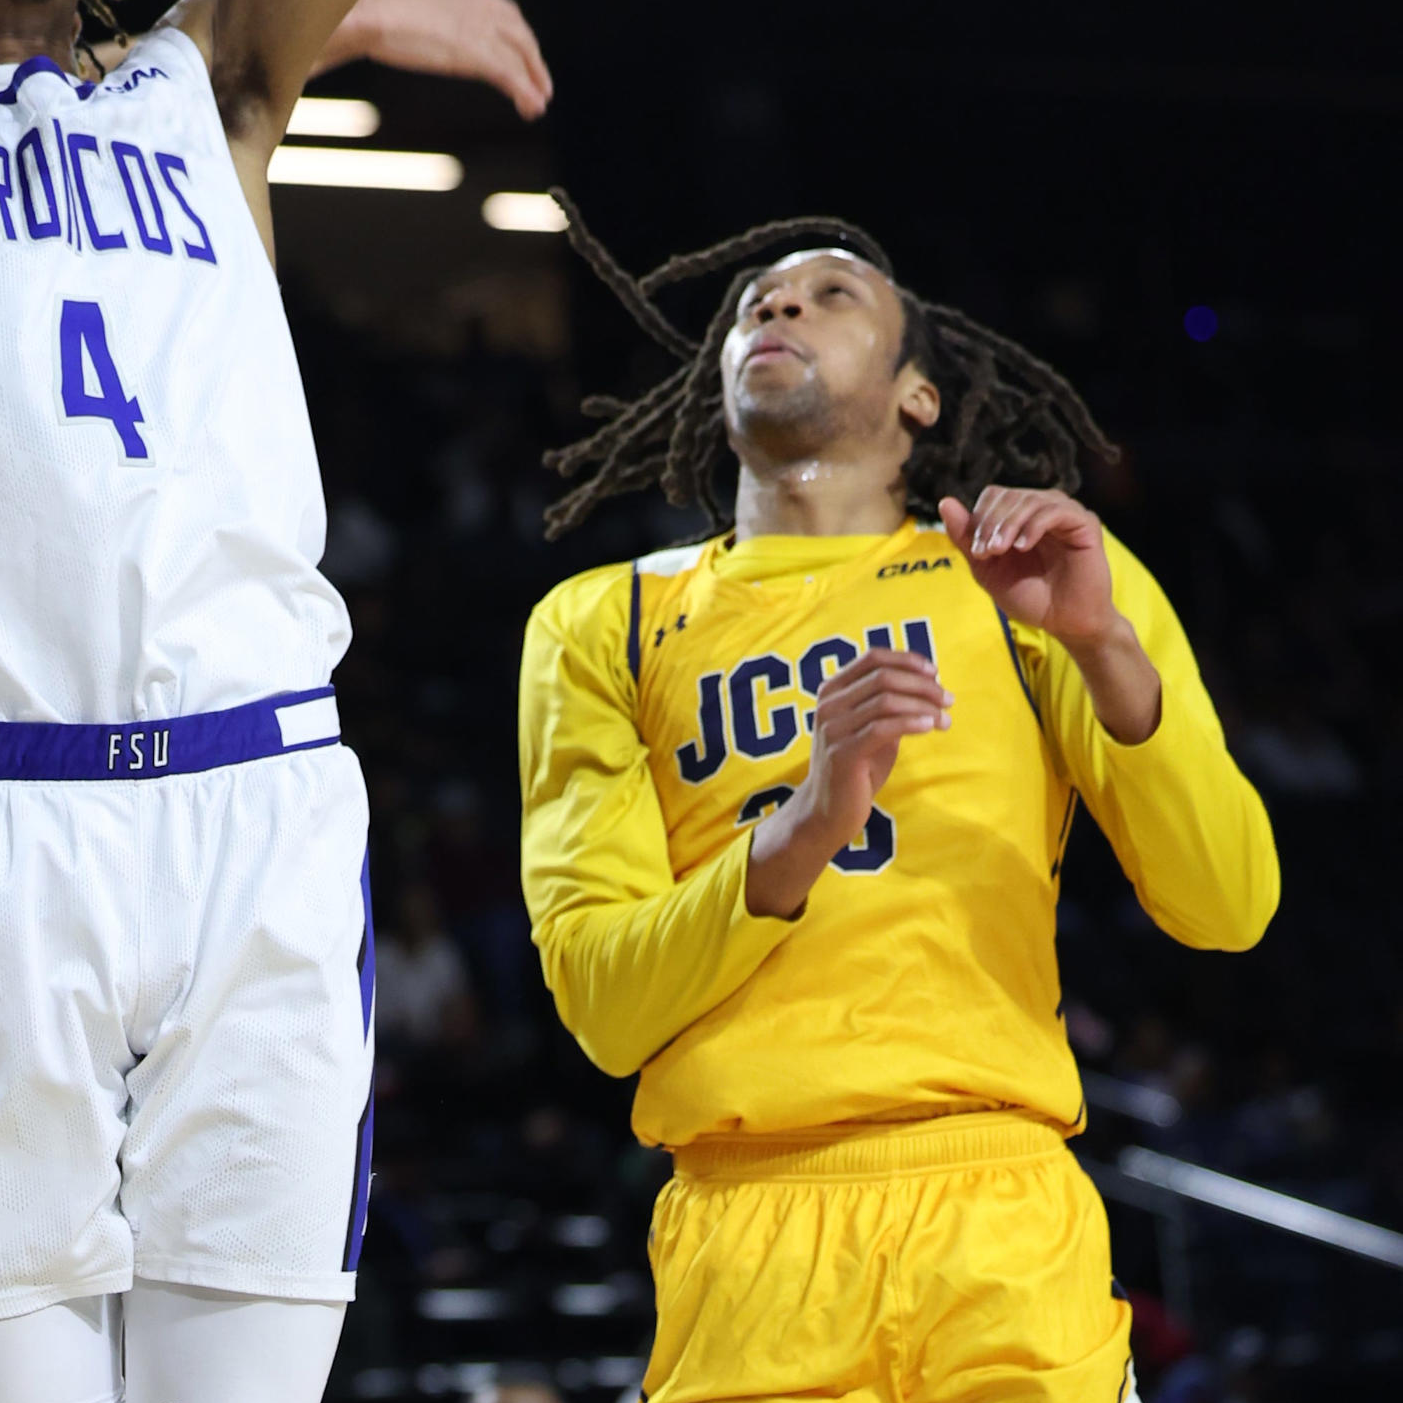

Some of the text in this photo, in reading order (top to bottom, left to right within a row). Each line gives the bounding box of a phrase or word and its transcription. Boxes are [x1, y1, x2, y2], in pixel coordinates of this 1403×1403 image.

[53, 293, 157, 467] 4
[877, 555, 952, 579] CIAA
[107, 729, 170, 771] FSU
